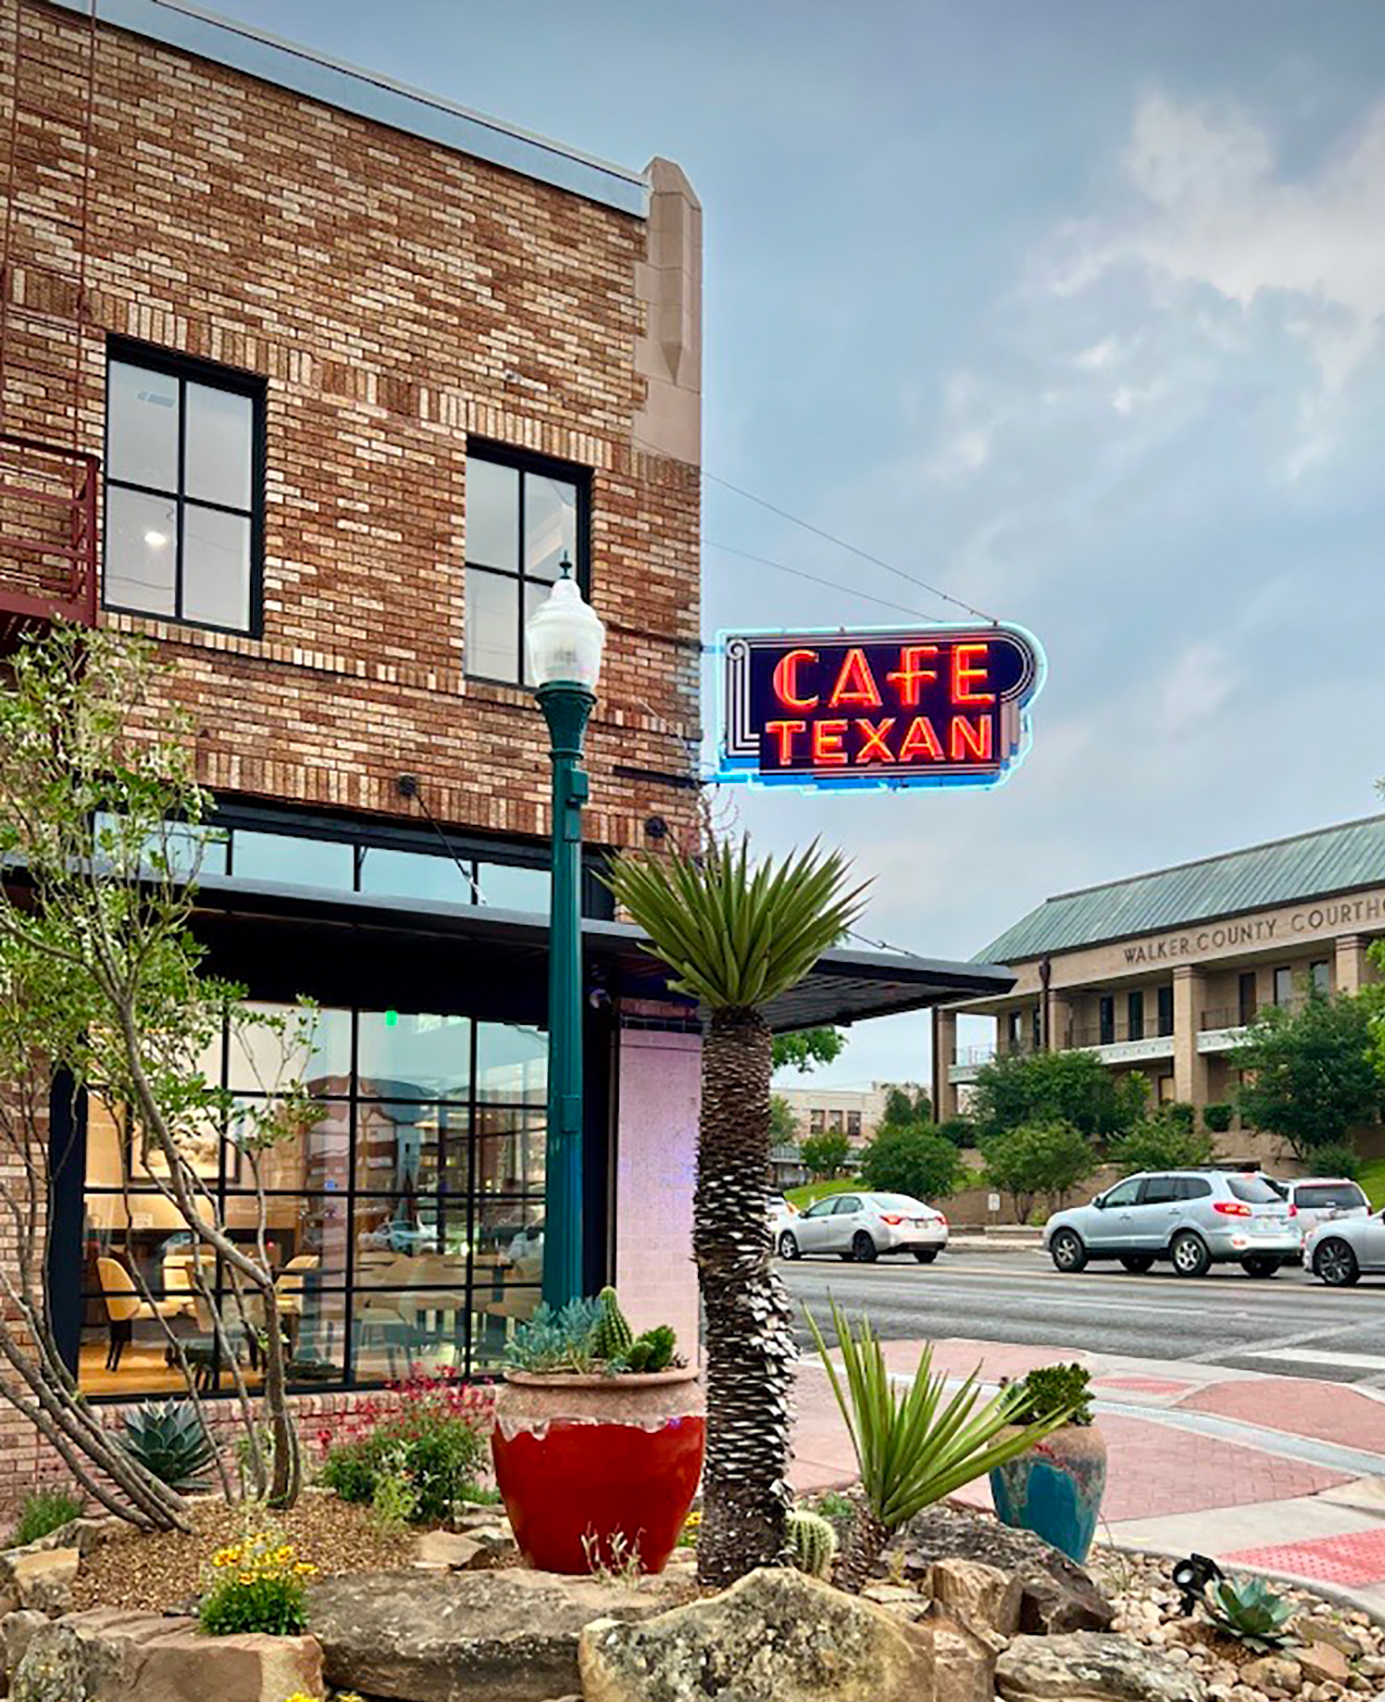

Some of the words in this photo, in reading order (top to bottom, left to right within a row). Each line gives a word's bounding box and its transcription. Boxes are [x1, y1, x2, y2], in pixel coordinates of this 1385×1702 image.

[772, 643, 997, 709] CAFE
[765, 714, 993, 766] TEXAN
[1123, 936, 1189, 965] WALKER
[1196, 918, 1277, 951] COUNTY
[1291, 897, 1385, 932] COURTH
